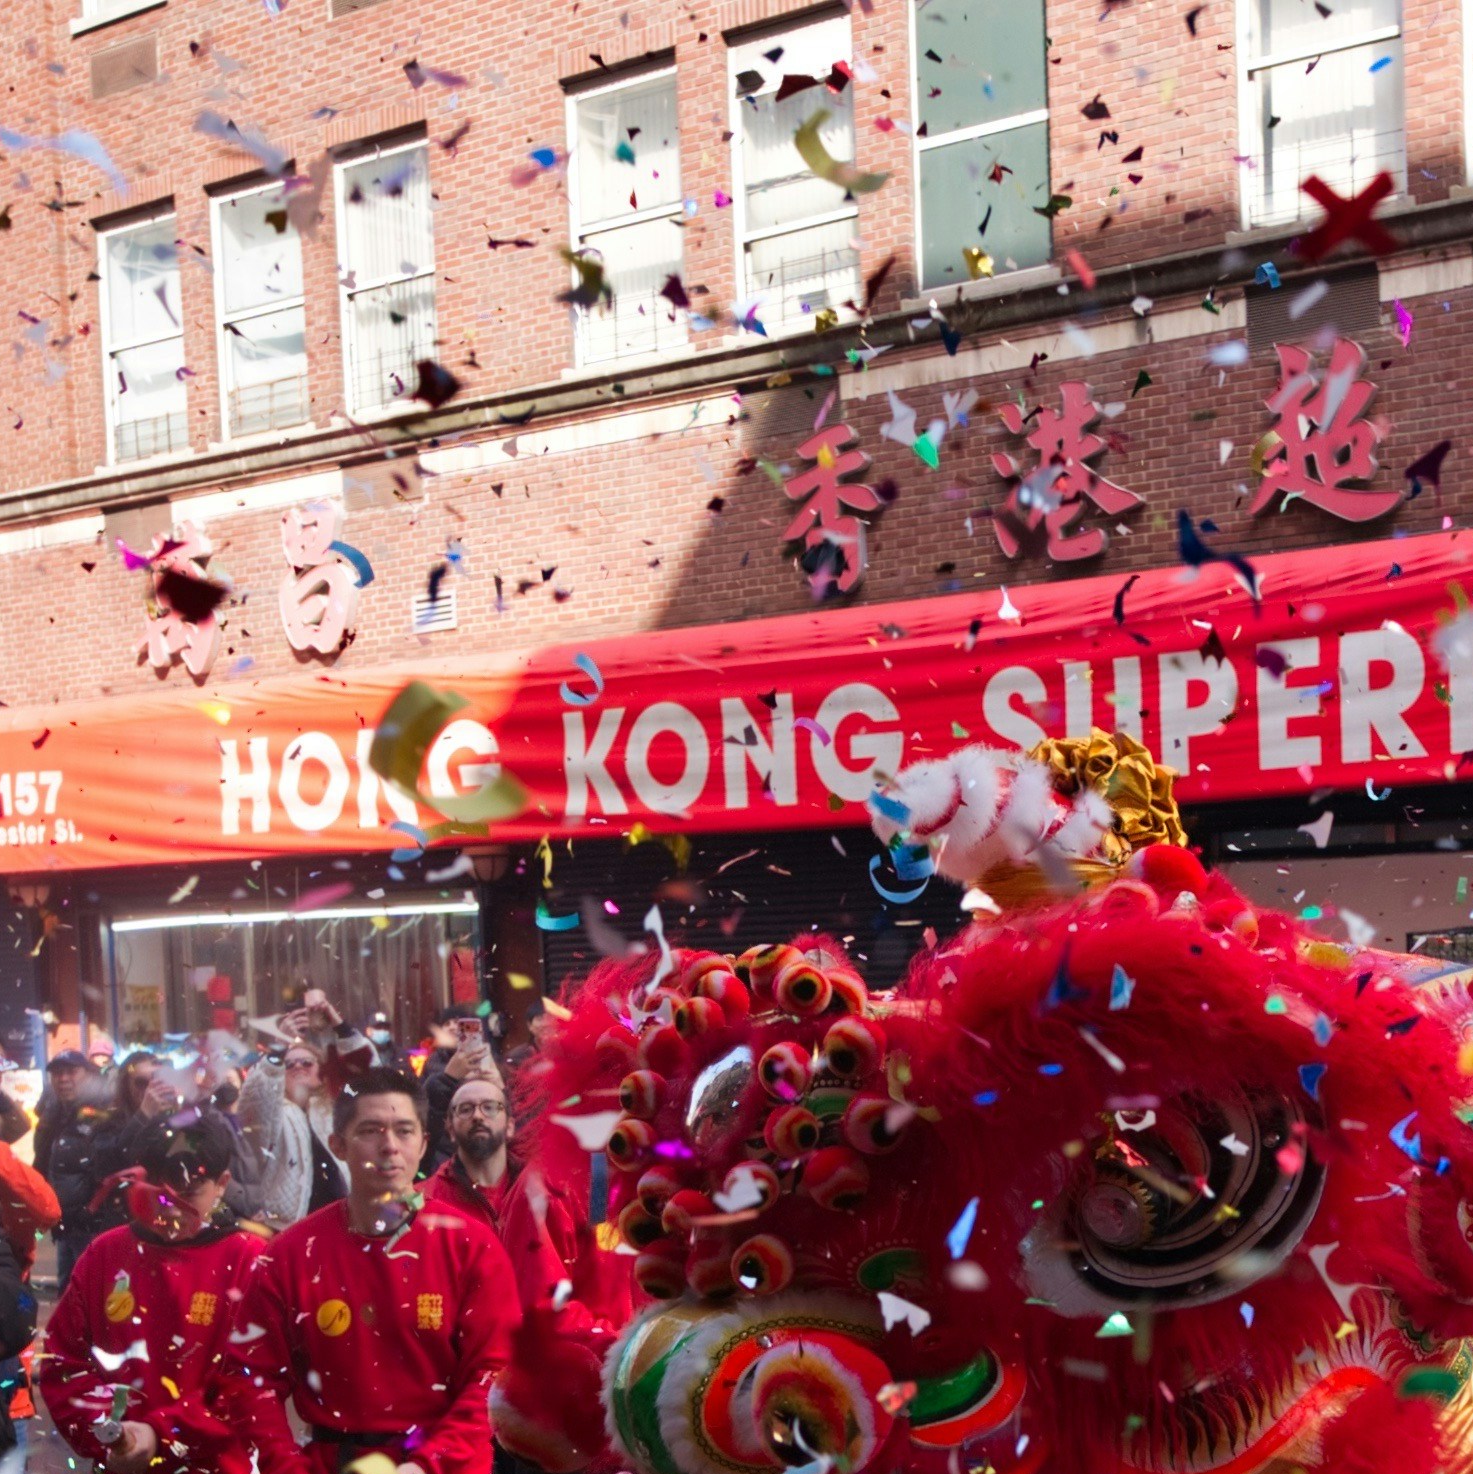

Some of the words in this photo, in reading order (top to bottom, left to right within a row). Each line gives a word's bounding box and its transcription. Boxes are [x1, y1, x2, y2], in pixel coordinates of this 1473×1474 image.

[220, 717, 502, 835] HONG
[562, 682, 904, 818] KONG
[54, 818, 83, 843] St.
